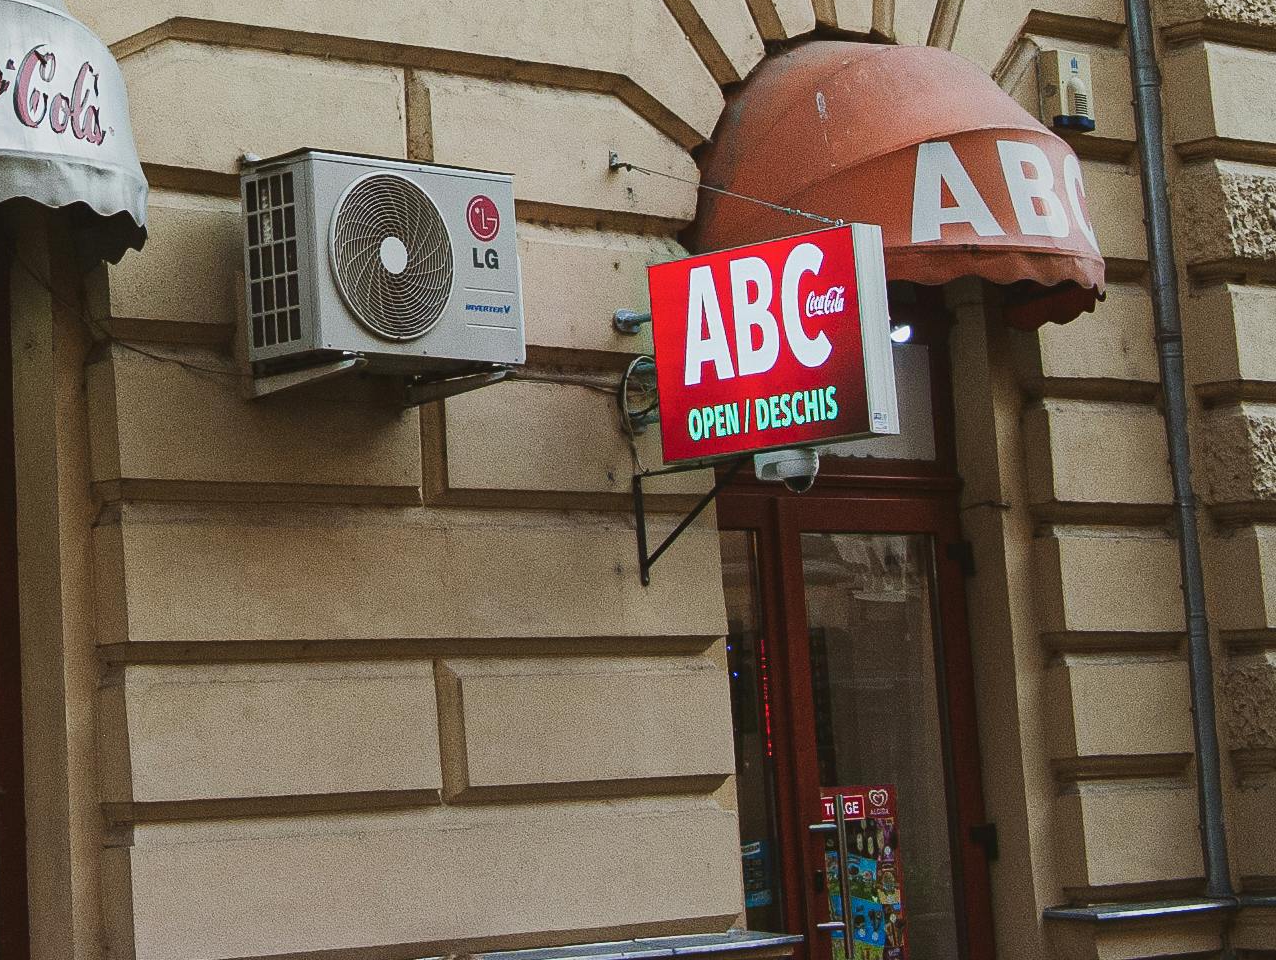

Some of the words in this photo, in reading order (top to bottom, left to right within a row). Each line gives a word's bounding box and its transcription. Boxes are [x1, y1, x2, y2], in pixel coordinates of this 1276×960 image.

[911, 139, 1101, 256] ABC
[472, 247, 500, 270] LG
[684, 242, 833, 387] ABC
[687, 401, 740, 441] OPEN
[754, 385, 839, 431] DESCHIS
[824, 801, 860, 815] TGE
